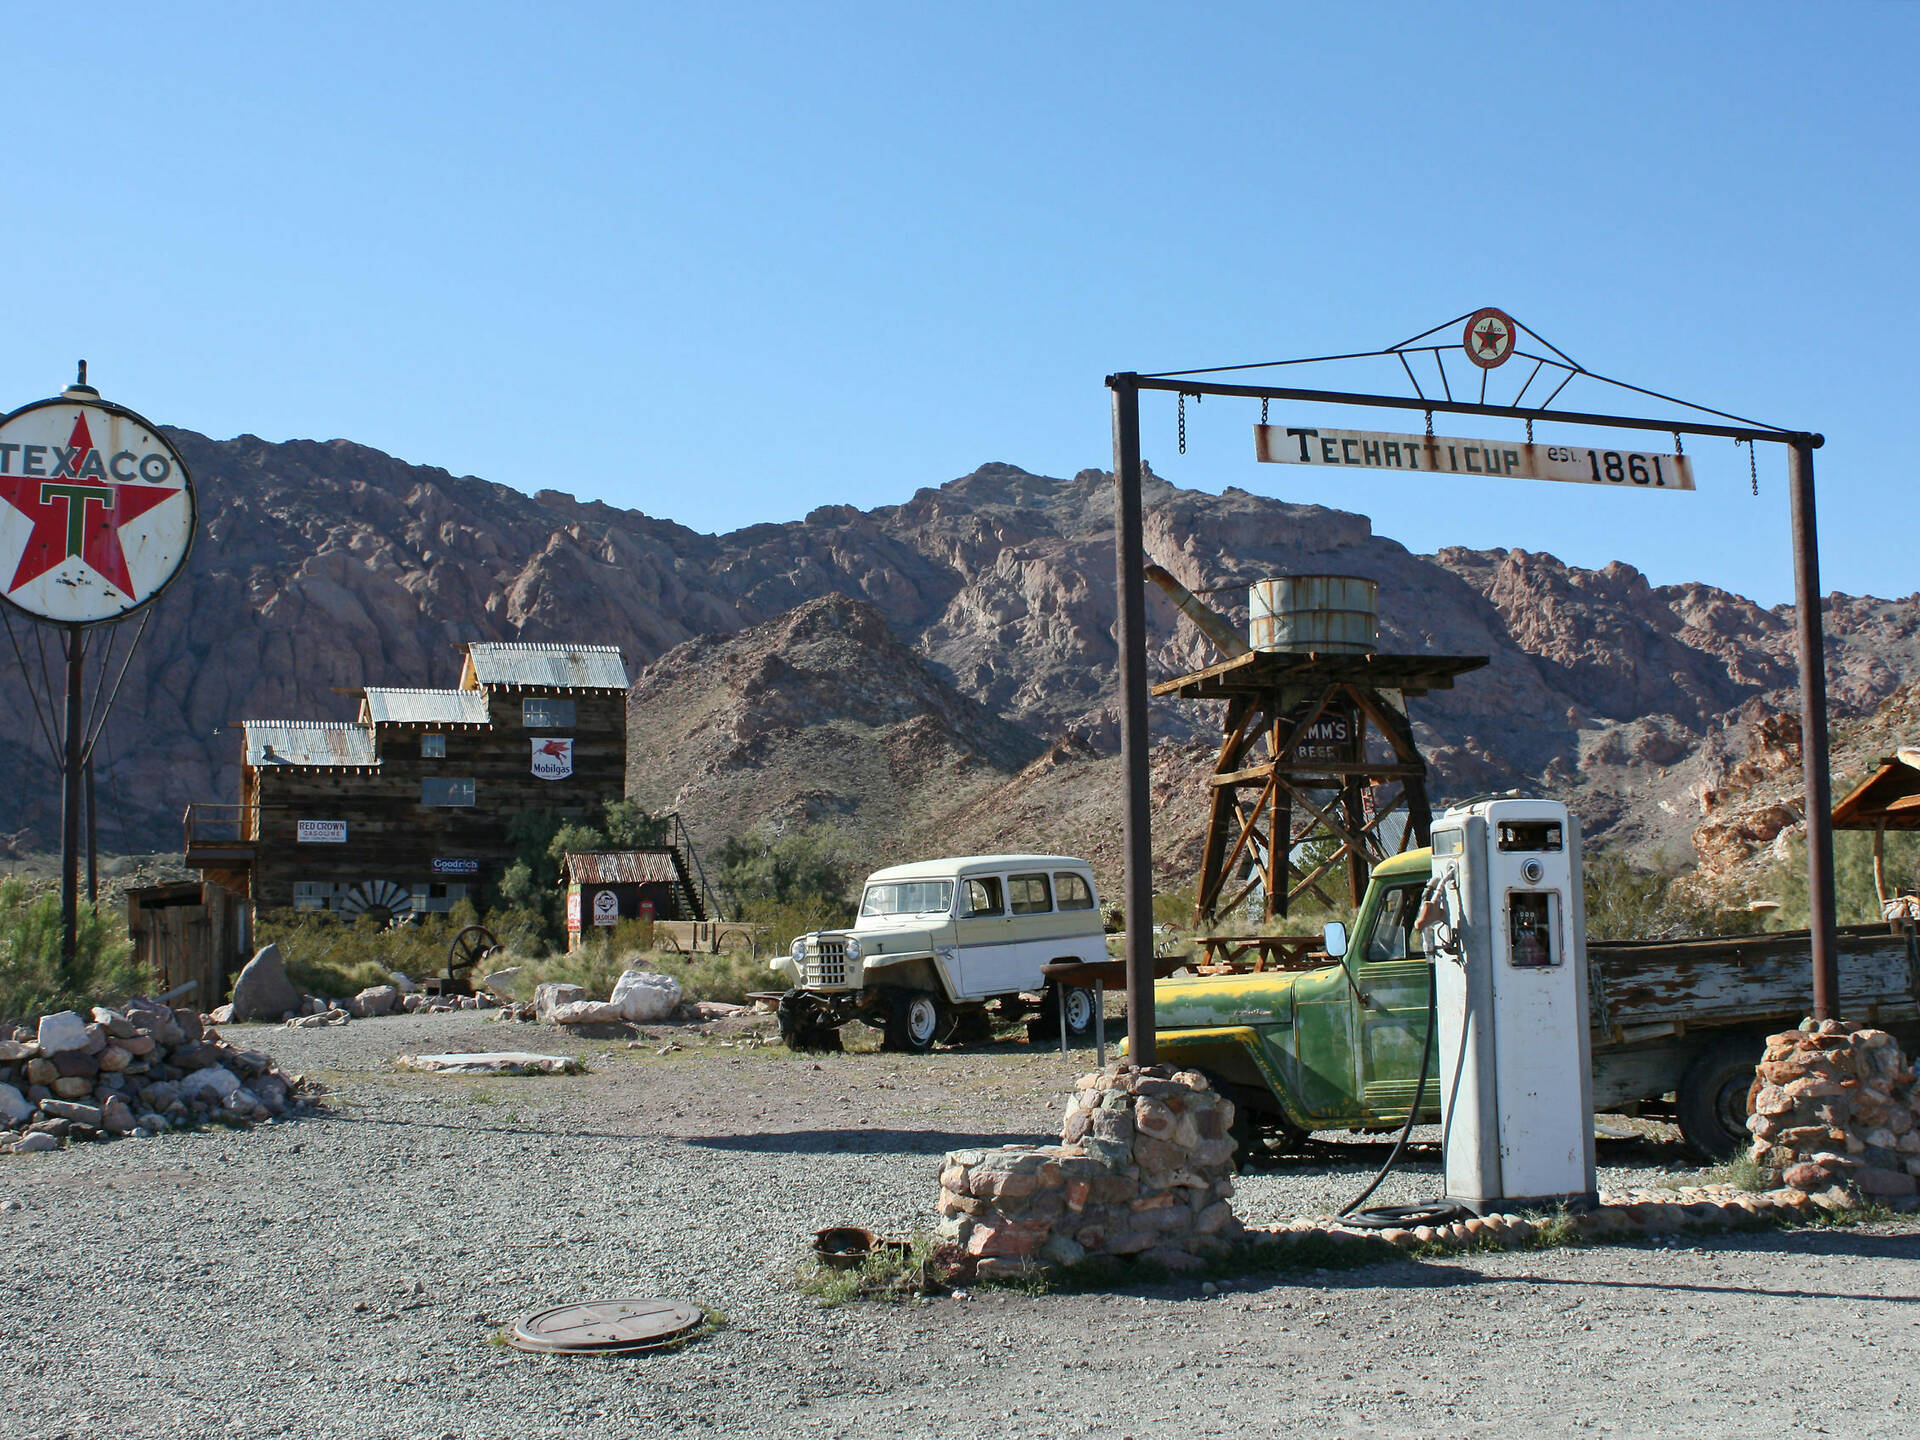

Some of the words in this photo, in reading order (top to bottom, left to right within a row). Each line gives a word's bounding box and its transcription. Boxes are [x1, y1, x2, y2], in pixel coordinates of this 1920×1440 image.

[1287, 428, 1519, 475] TECHATTICUP
[0, 443, 171, 484] TEXACO
[1304, 721, 1346, 740] MM'S
[533, 763, 571, 775] Mobilgas
[299, 822, 316, 831] RED
[317, 822, 345, 831] CROWN
[433, 859, 478, 868] Goodrich
